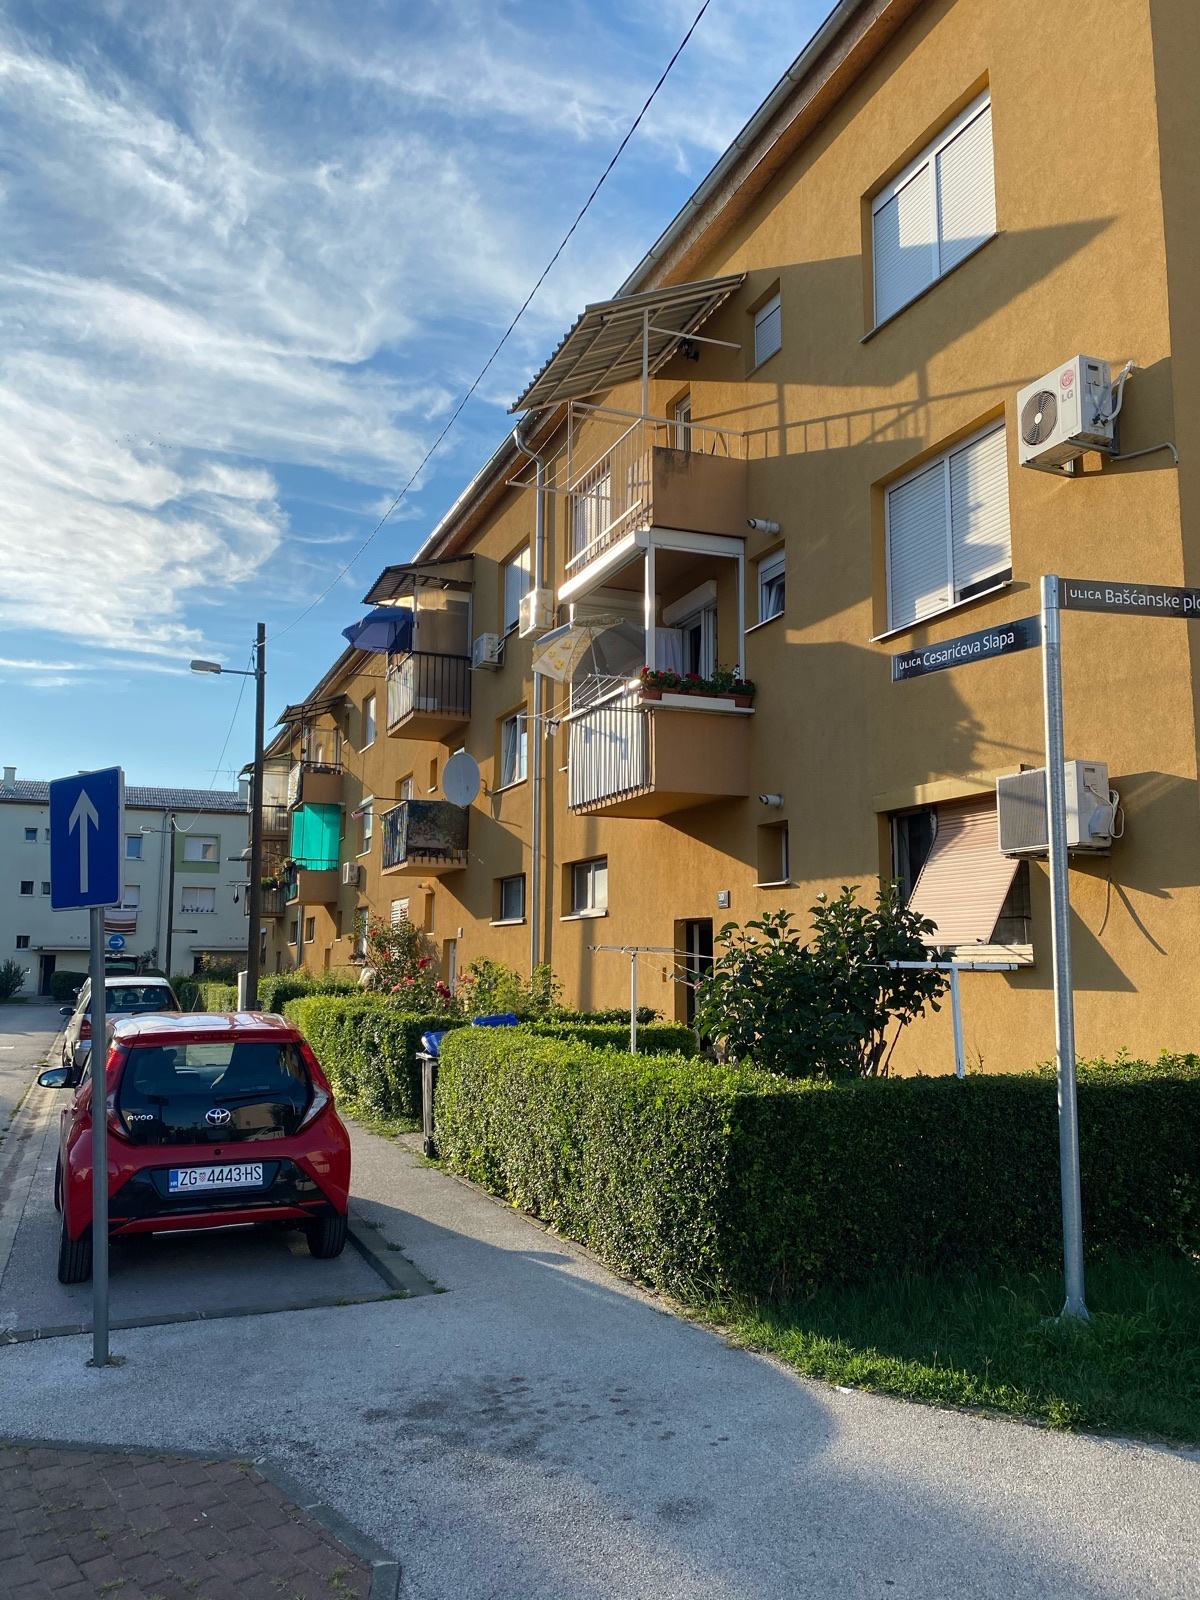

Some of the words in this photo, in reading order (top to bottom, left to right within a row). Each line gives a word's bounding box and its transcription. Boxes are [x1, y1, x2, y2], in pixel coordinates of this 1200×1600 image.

[1061, 390, 1074, 402] LG
[1069, 589, 1102, 600] ULICA
[1105, 588, 1180, 608] Bašćanske
[899, 657, 922, 670] ULICA
[923, 641, 981, 666] Cesarićeva
[983, 632, 1015, 650] Slapa
[180, 1170, 197, 1186] ZG
